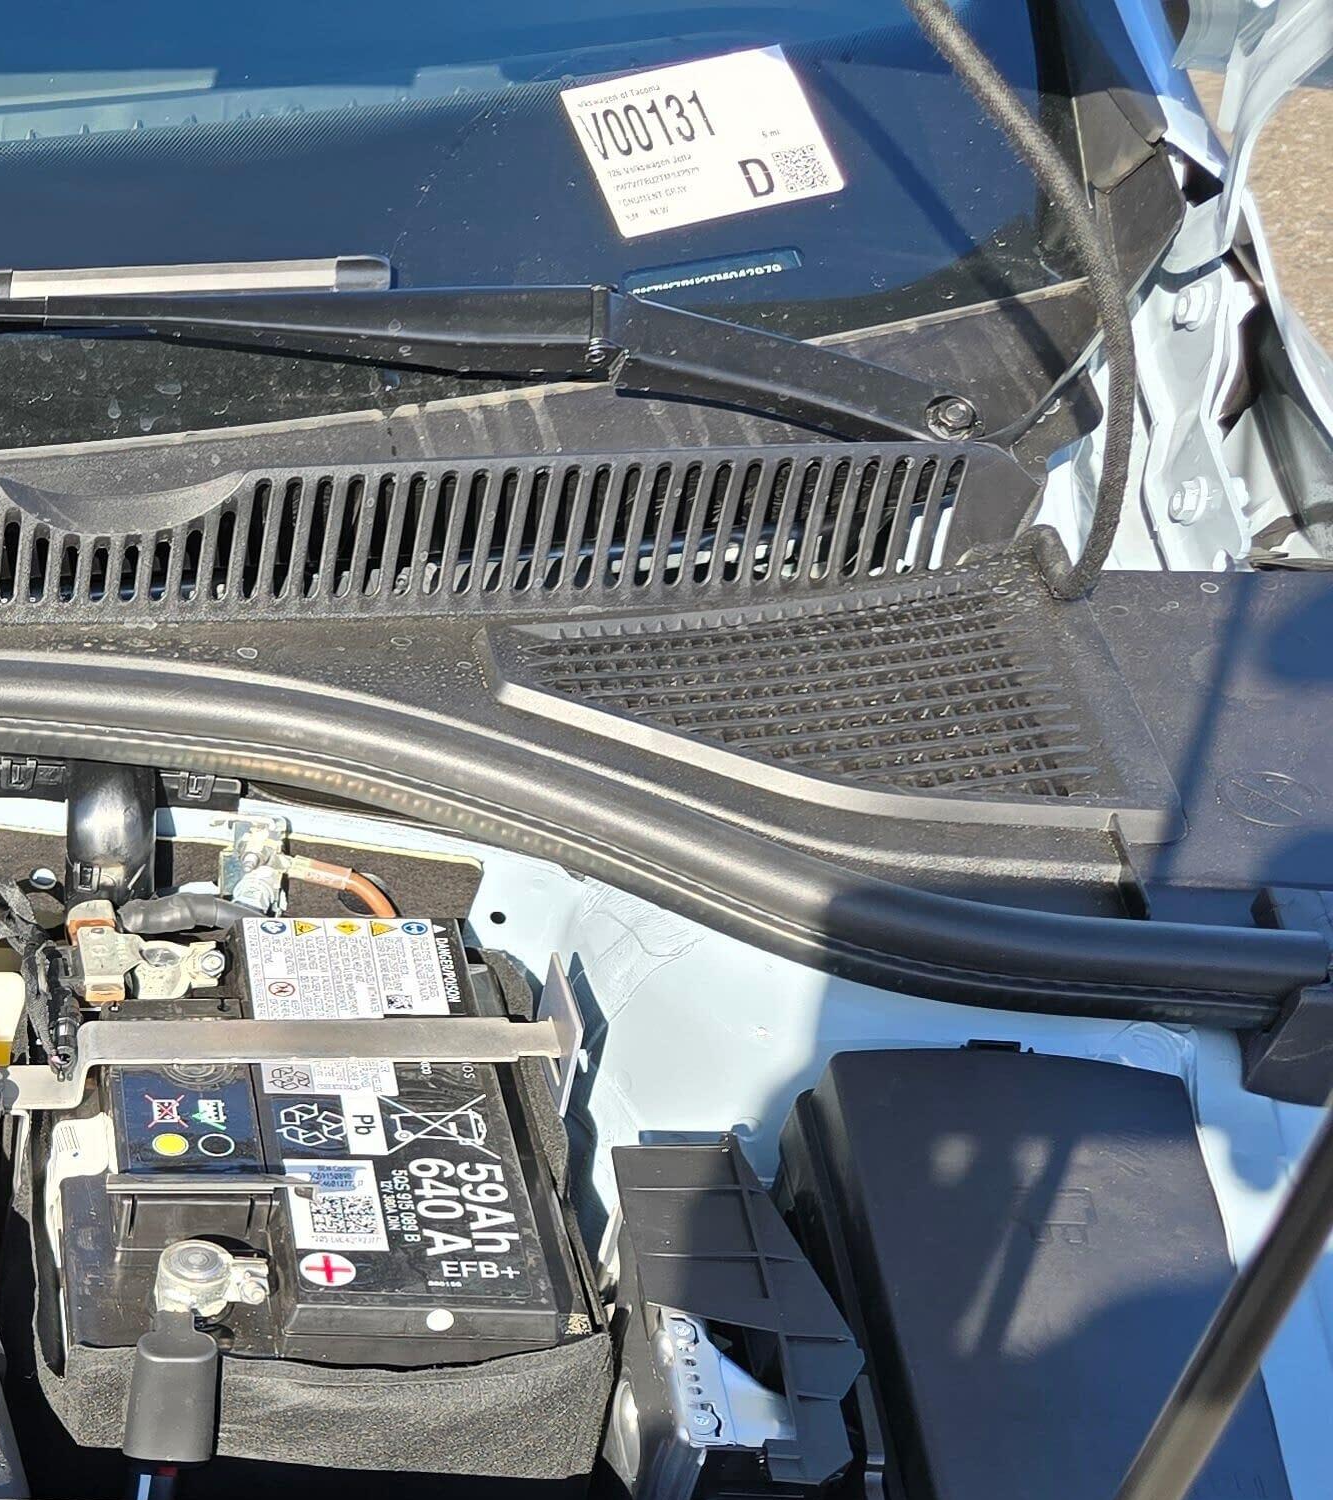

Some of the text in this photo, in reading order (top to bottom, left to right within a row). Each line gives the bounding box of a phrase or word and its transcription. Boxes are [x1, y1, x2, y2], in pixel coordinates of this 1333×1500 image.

[630, 84, 661, 96] Tacoma
[577, 90, 715, 160] V00131
[738, 158, 775, 198] D
[435, 937, 461, 1003] DANGER/POISON
[354, 1115, 375, 1136] Pb
[391, 1169, 421, 1242] 5QS 915 089 B
[409, 1158, 465, 1220] 640
[456, 1161, 520, 1254] 59Ah
[386, 1216, 401, 1231] DIN
[422, 1228, 473, 1256] A
[441, 1260, 520, 1279] EFB+
